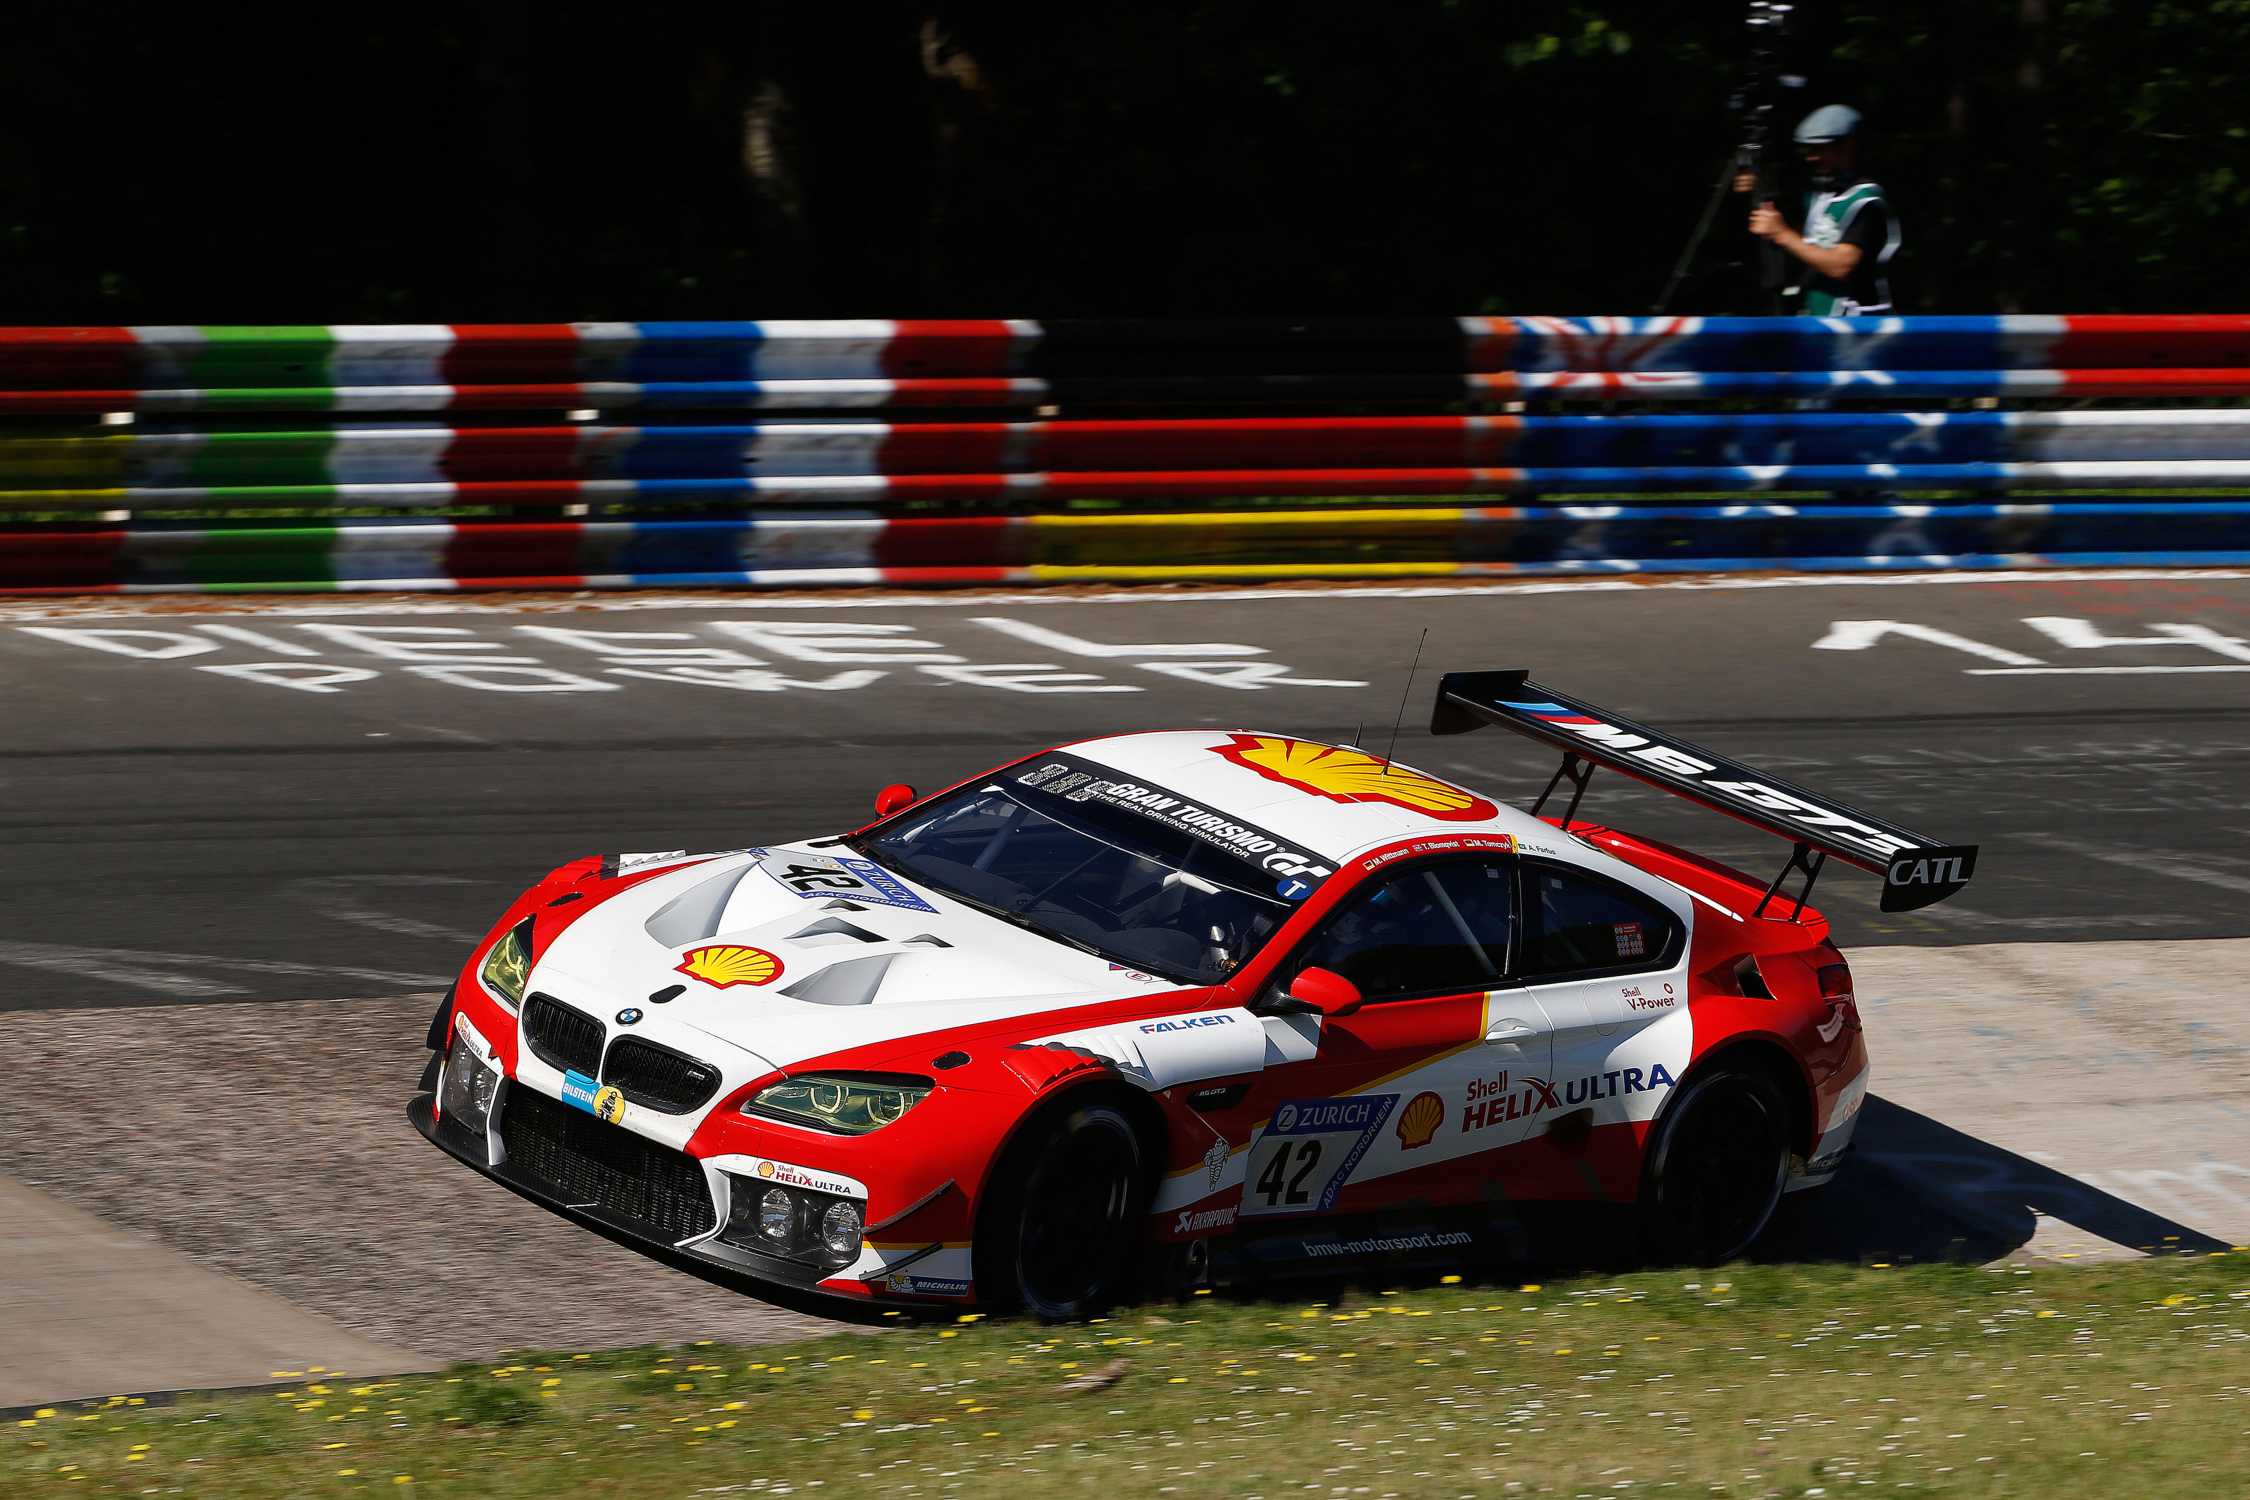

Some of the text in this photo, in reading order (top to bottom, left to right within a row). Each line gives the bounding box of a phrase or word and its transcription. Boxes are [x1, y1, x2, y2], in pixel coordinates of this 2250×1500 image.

[16, 617, 1271, 665] DIESEL
[194, 662, 1369, 692] POWER
[1110, 783, 1175, 817] GRAN
[1547, 721, 1920, 855] M6 GT3
[1098, 792, 1251, 859] THE REAL DRIVING SIMULATOR
[780, 864, 864, 891] 42
[1888, 856, 1969, 886] CATL
[861, 870, 917, 902] ZURICH
[1284, 880, 1307, 897] T
[848, 894, 932, 912] NORDRHEIN
[1622, 986, 1641, 997] Shell
[1627, 997, 1675, 1010] V-Power
[1140, 1015, 1235, 1034] FALKEN
[563, 1083, 595, 1105] BILSTEIN
[1462, 1064, 1676, 1133] HELIX ULTRA
[1466, 1070, 1508, 1101] Shell
[1299, 1103, 1371, 1127] ZURICH
[1323, 1097, 1393, 1208] ADAC NORDRHEIN
[778, 1165, 794, 1173] Shell
[1256, 1140, 1322, 1206] 42
[775, 1172, 851, 1194] HELIX ULTRA
[1302, 1231, 1472, 1256] bmw-motorsport.com
[916, 1281, 968, 1290] MICHELIN
